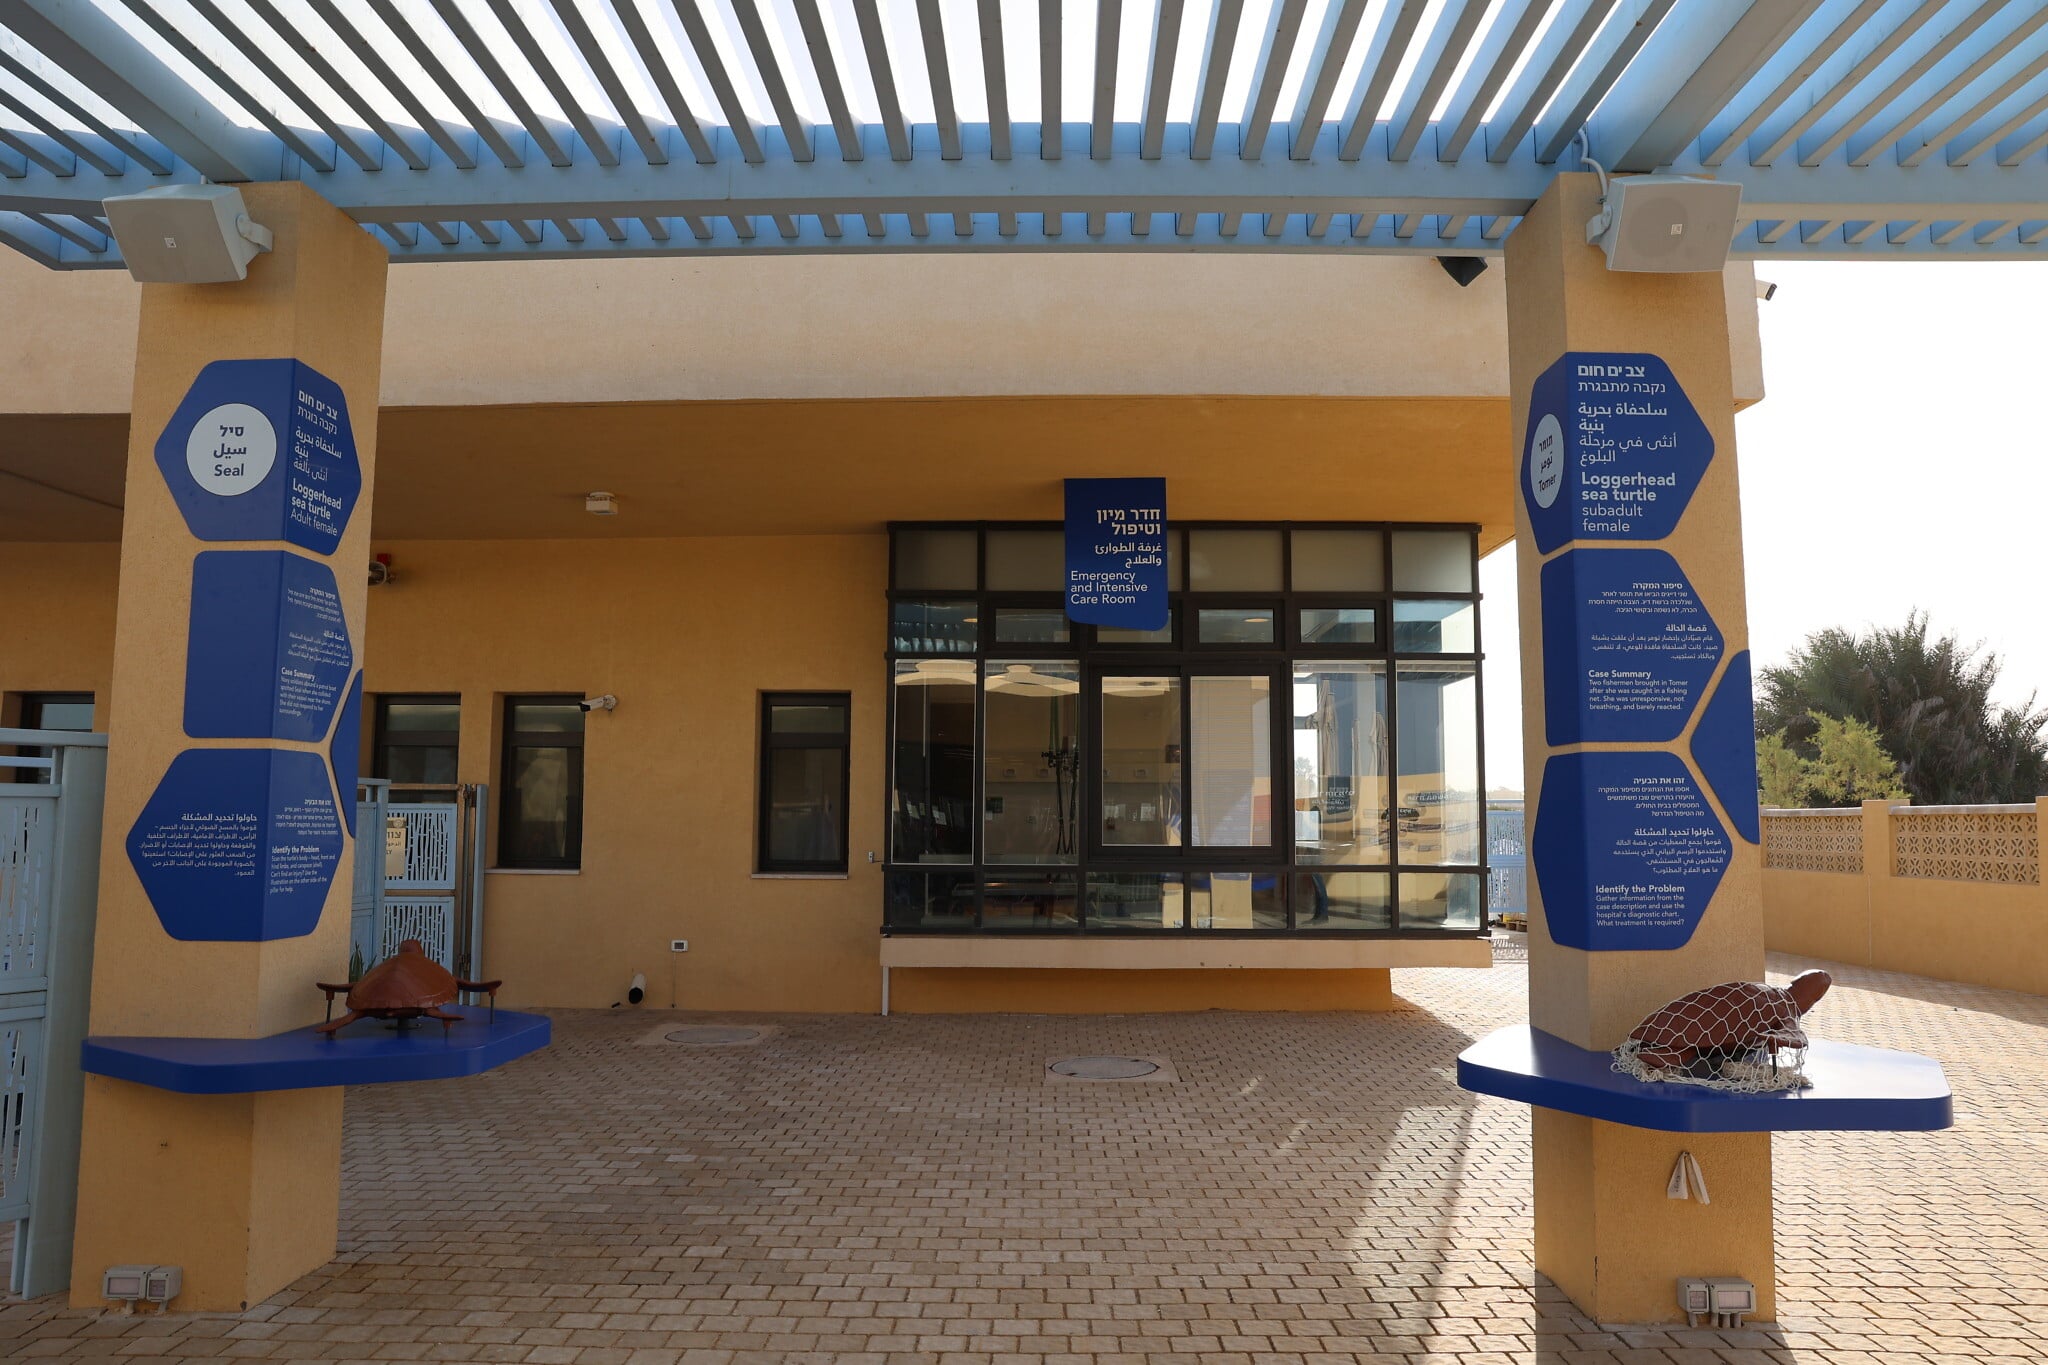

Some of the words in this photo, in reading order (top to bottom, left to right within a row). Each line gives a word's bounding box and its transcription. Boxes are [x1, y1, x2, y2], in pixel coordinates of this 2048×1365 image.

[1578, 366, 1604, 377] חום
[1608, 366, 1622, 377] ים
[1625, 366, 1645, 377] צב
[1578, 382, 1629, 392] מתבגרת
[1634, 382, 1666, 394] נקבה
[299, 390, 314, 405] חום
[316, 400, 325, 412] ים
[1578, 403, 1611, 416] بحرية
[1616, 403, 1667, 415] سلحفاة
[298, 406, 318, 424] בוגרת
[327, 406, 337, 420] צב
[220, 425, 244, 437] סיל
[320, 418, 337, 435] נקבה
[1579, 419, 1604, 434] بنية
[296, 426, 314, 448] بحرية
[1539, 435, 1552, 452] תומר
[1579, 434, 1614, 448] مرحلة
[1619, 435, 1643, 452] في
[1647, 432, 1676, 448] أنثى
[214, 443, 247, 459] سيل
[295, 442, 308, 458] بنية
[316, 436, 342, 459] سلحفاة
[1541, 451, 1552, 473] تومر
[1580, 450, 1616, 466] البلوغ
[214, 463, 244, 476] Seal
[294, 458, 310, 476] بالغة
[312, 468, 327, 482] أنثى
[1581, 472, 1676, 488] Loggerhead
[1539, 474, 1556, 492] Tomer
[293, 478, 341, 510] Loggerhead
[1582, 489, 1608, 500] sea
[1612, 489, 1656, 501] turtle
[292, 496, 306, 509] sea
[308, 502, 330, 520] turtle
[1130, 509, 1160, 520] חדר
[1582, 505, 1643, 516] subadult
[291, 508, 311, 526] Adult
[314, 516, 337, 536] female
[1097, 509, 1125, 524] מיון
[1112, 522, 1160, 535] וטיפול
[1583, 520, 1630, 532] female
[1095, 543, 1134, 554] الطوارئ
[1138, 543, 1161, 553] غرفة
[1125, 555, 1161, 568] والعلاج
[1071, 571, 1135, 583] Emergency
[1071, 582, 1092, 592] and
[1096, 581, 1147, 592] Intensive
[1071, 594, 1098, 604] Care
[1102, 594, 1135, 604] Room
[1666, 624, 1685, 632] الحالة
[282, 667, 292, 675] Case
[294, 669, 315, 681] Summary
[1589, 670, 1609, 678] Case
[1612, 670, 1651, 679] Summary
[1635, 679, 1660, 687] brought
[1666, 687, 1687, 695] fishing
[1669, 829, 1689, 837] تحديد
[1692, 828, 1714, 837] حاولوا
[1596, 885, 1629, 895] Identify
[1632, 885, 1646, 893] the
[1649, 884, 1685, 893] Problem
[1596, 911, 1626, 919] hospital's
